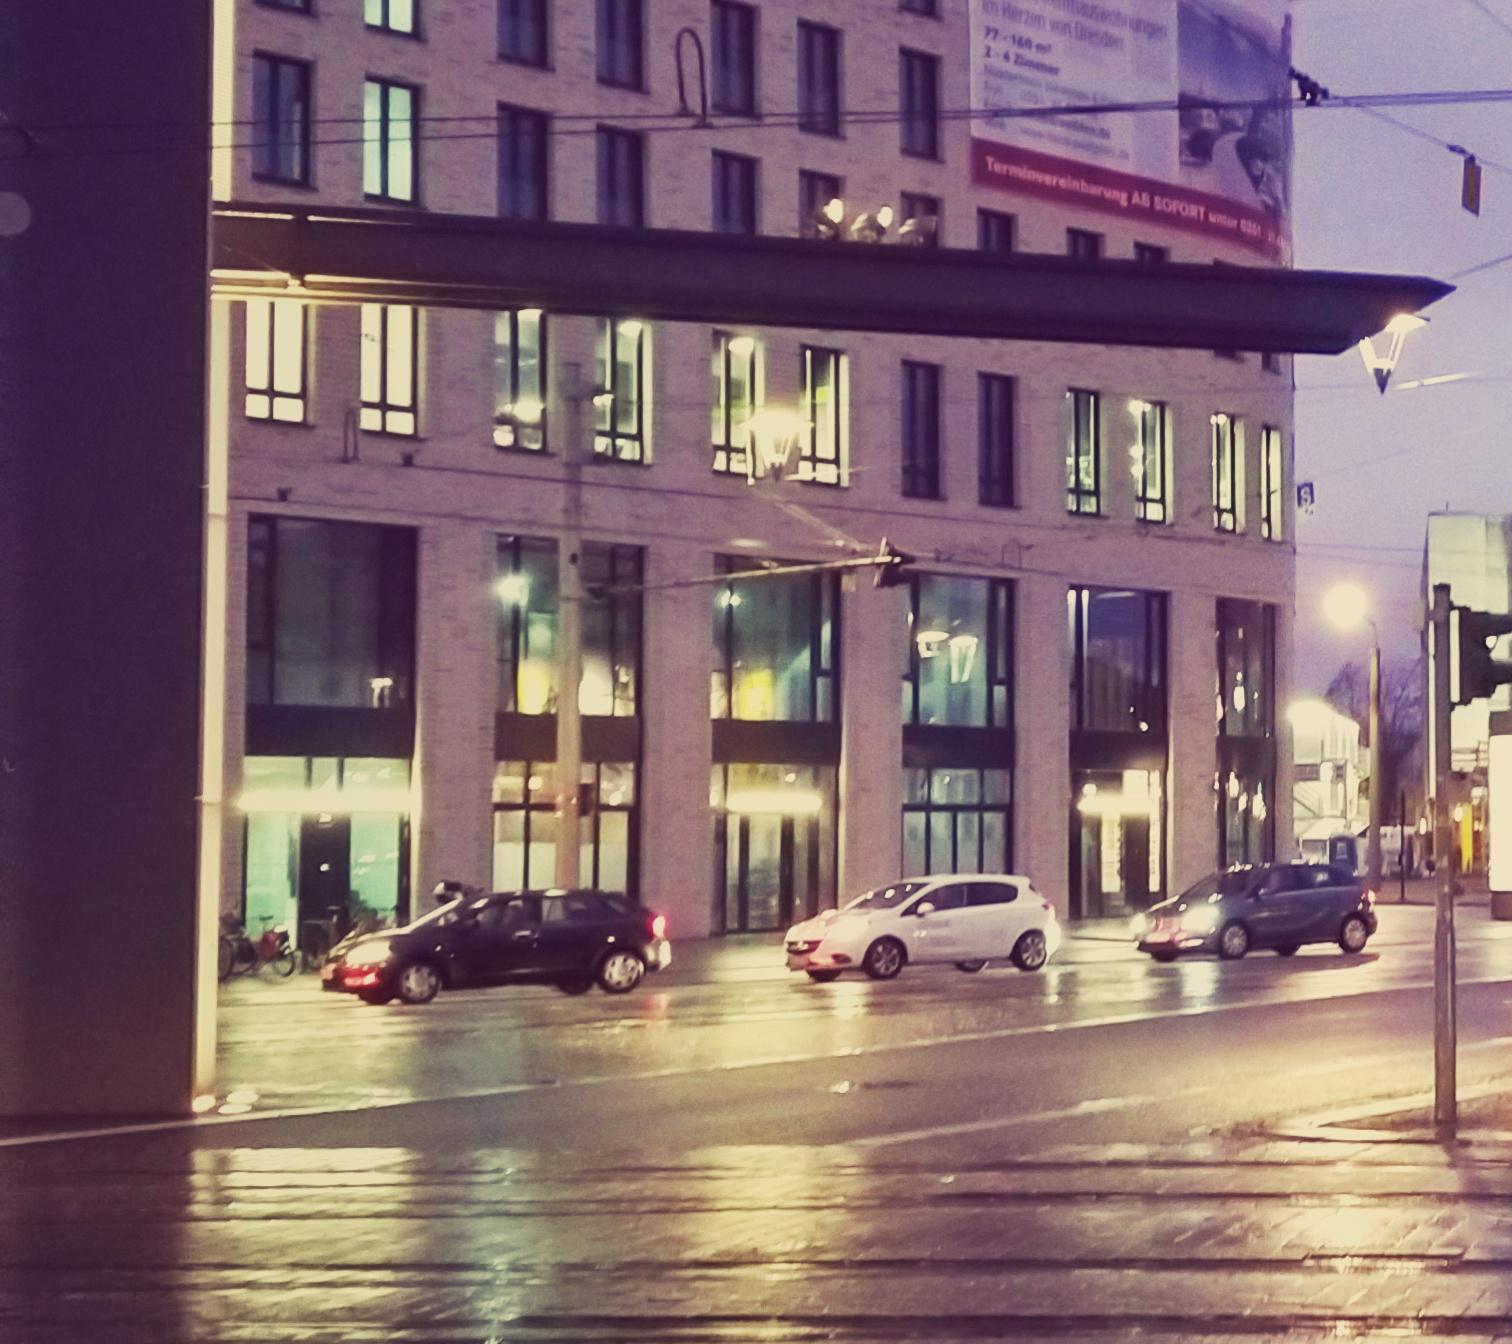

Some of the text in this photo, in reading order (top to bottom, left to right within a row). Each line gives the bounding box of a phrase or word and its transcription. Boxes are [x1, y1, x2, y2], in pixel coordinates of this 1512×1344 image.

[1014, 53, 1060, 76] Zimmer
[985, 156, 1128, 208] Terminvereinbarung
[1131, 190, 1151, 208] AB
[1153, 195, 1206, 220] SOFORT
